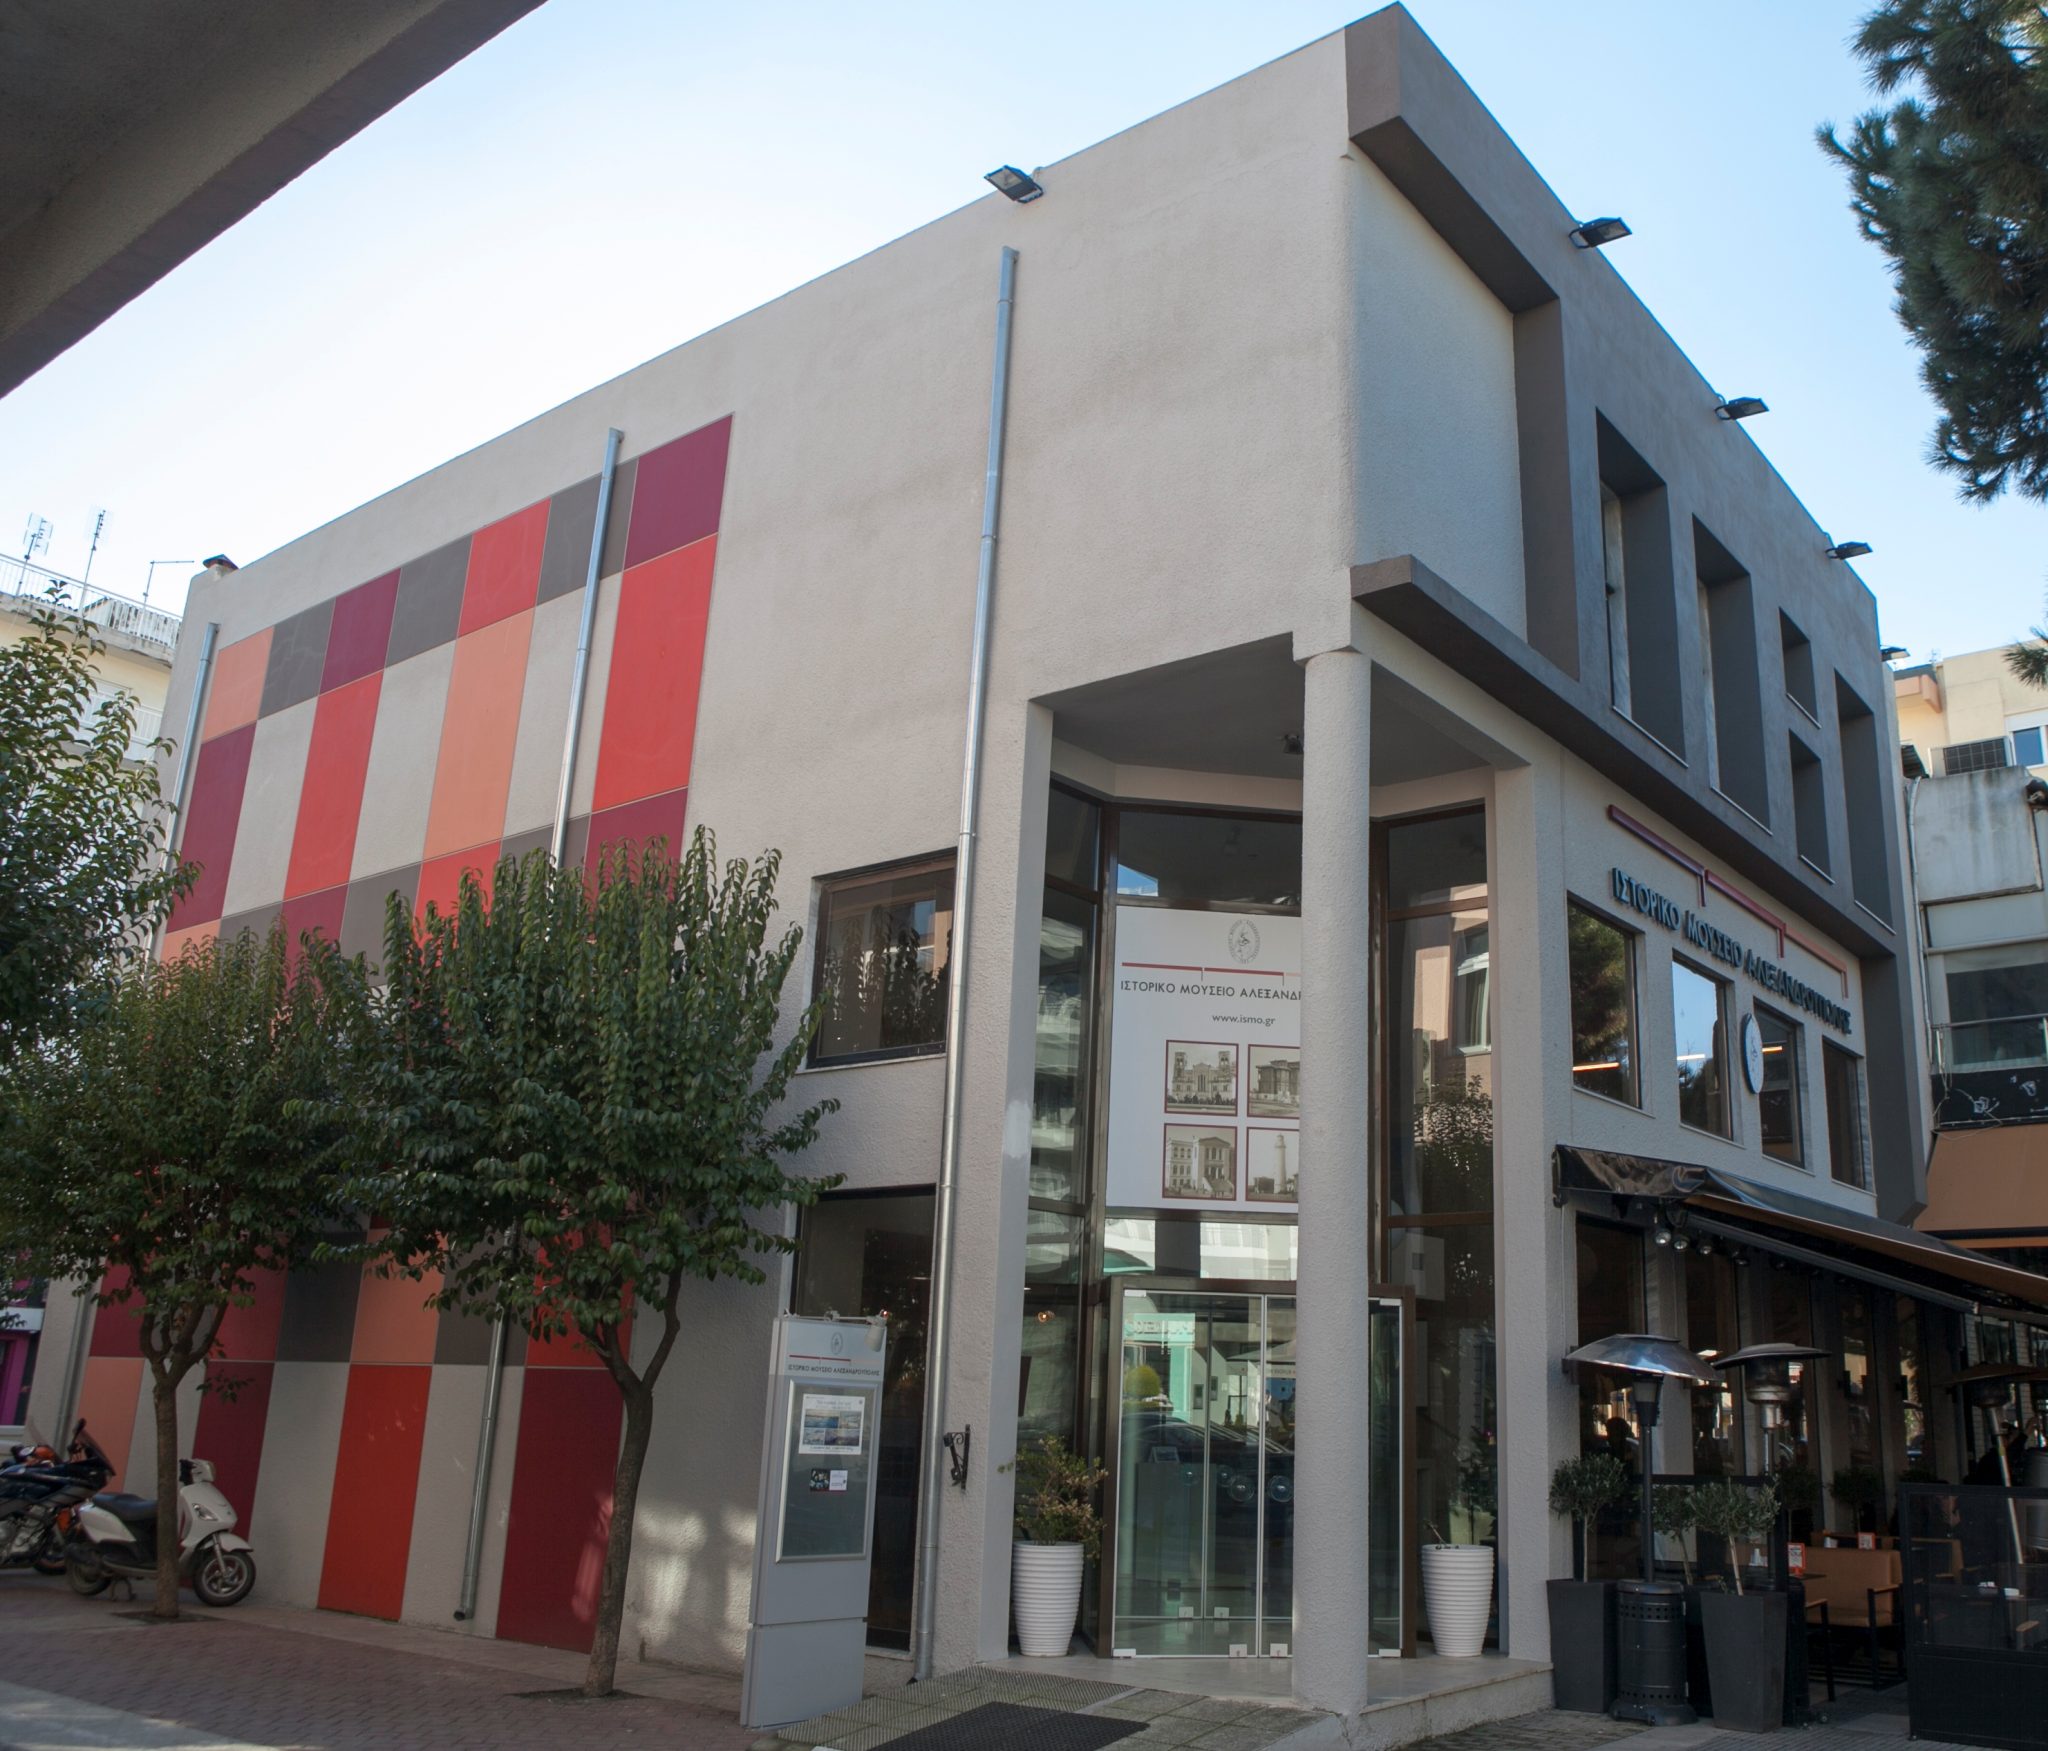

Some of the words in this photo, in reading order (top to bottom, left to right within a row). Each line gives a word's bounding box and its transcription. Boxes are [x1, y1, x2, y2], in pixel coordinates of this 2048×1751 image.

[1611, 868, 1682, 931] ΙΣΤΟΡΙΚΟ
[1684, 910, 1742, 968] ΜΟΥΣΕΙΟ
[1120, 980, 1176, 993] ΙΣΤΟΡΙΚΟ
[1180, 984, 1235, 997] ΜΟΥΣΕΙΟ
[1212, 1014, 1276, 1027] www.ismo.gr
